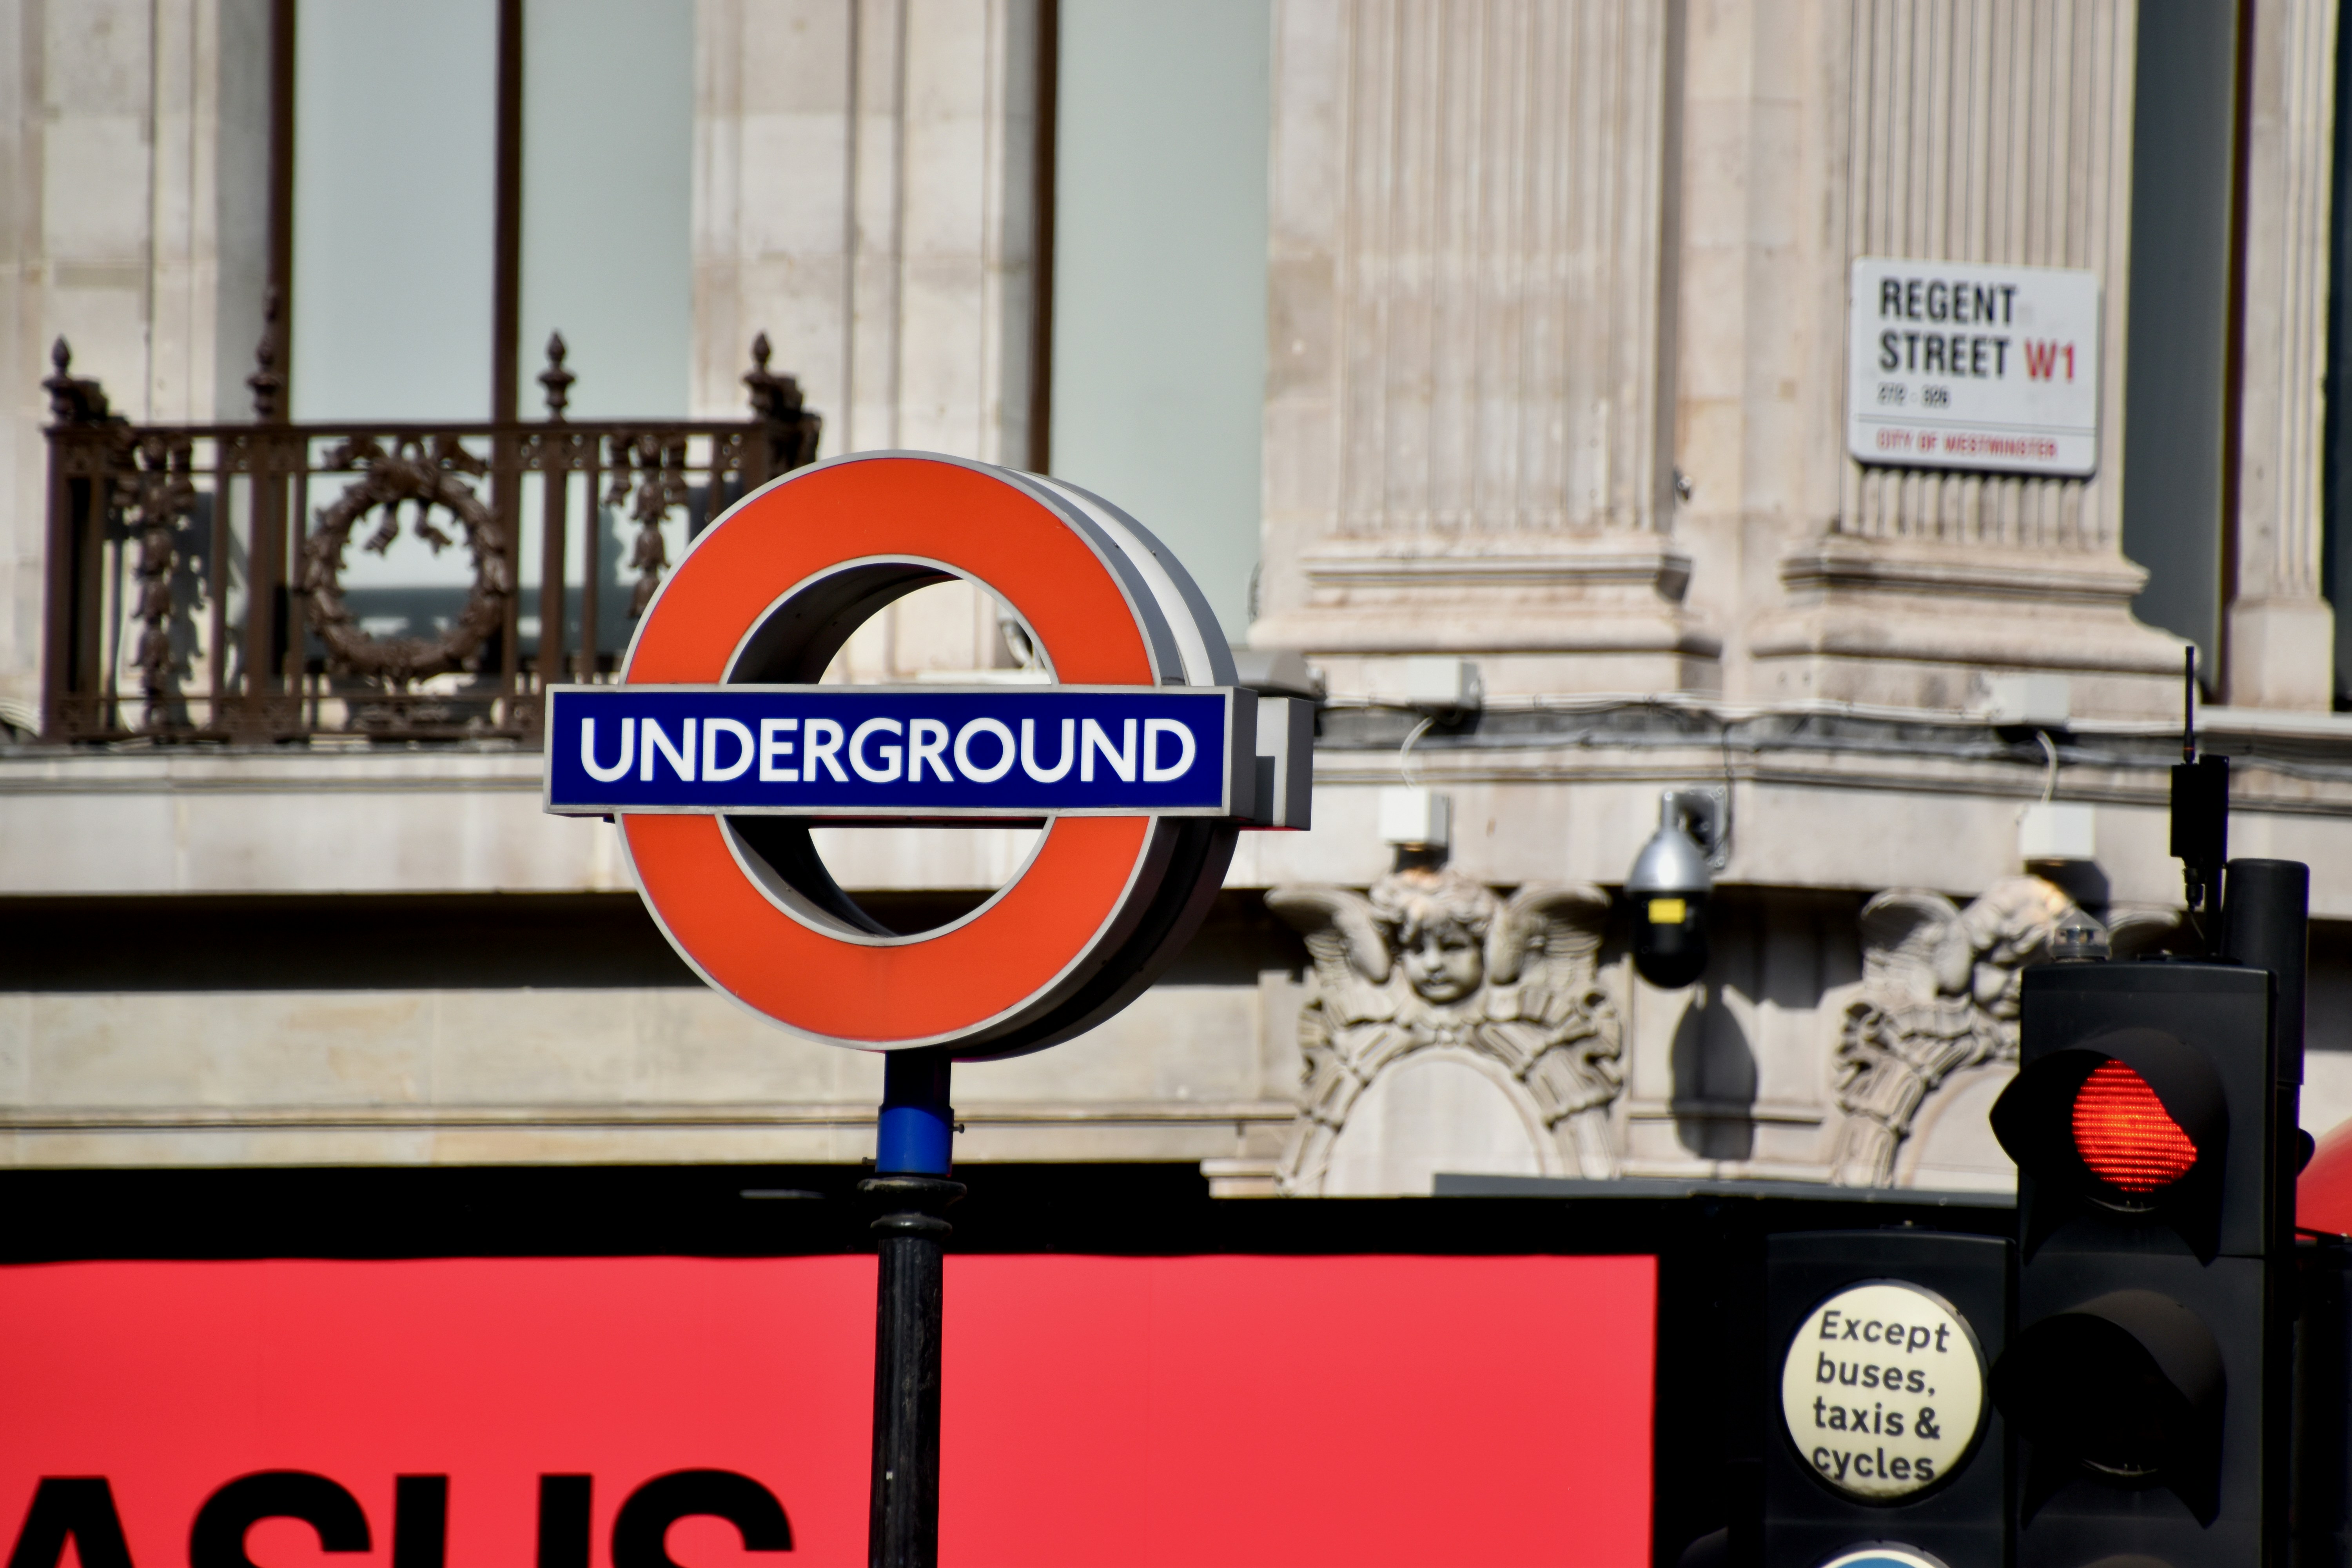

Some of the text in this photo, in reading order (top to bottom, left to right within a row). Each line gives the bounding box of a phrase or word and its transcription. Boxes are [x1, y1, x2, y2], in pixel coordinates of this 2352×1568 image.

[1880, 277, 2017, 326] REGENT
[1879, 329, 2075, 383] STREET W1
[1877, 428, 2059, 461] CITY OF WESTMINSTER
[580, 717, 1197, 784] UNDERGROUND
[1819, 1310, 1950, 1353] Except
[1815, 1352, 1935, 1396] buses,
[1813, 1396, 1940, 1439] taxis &
[1812, 1445, 1935, 1481] cycles
